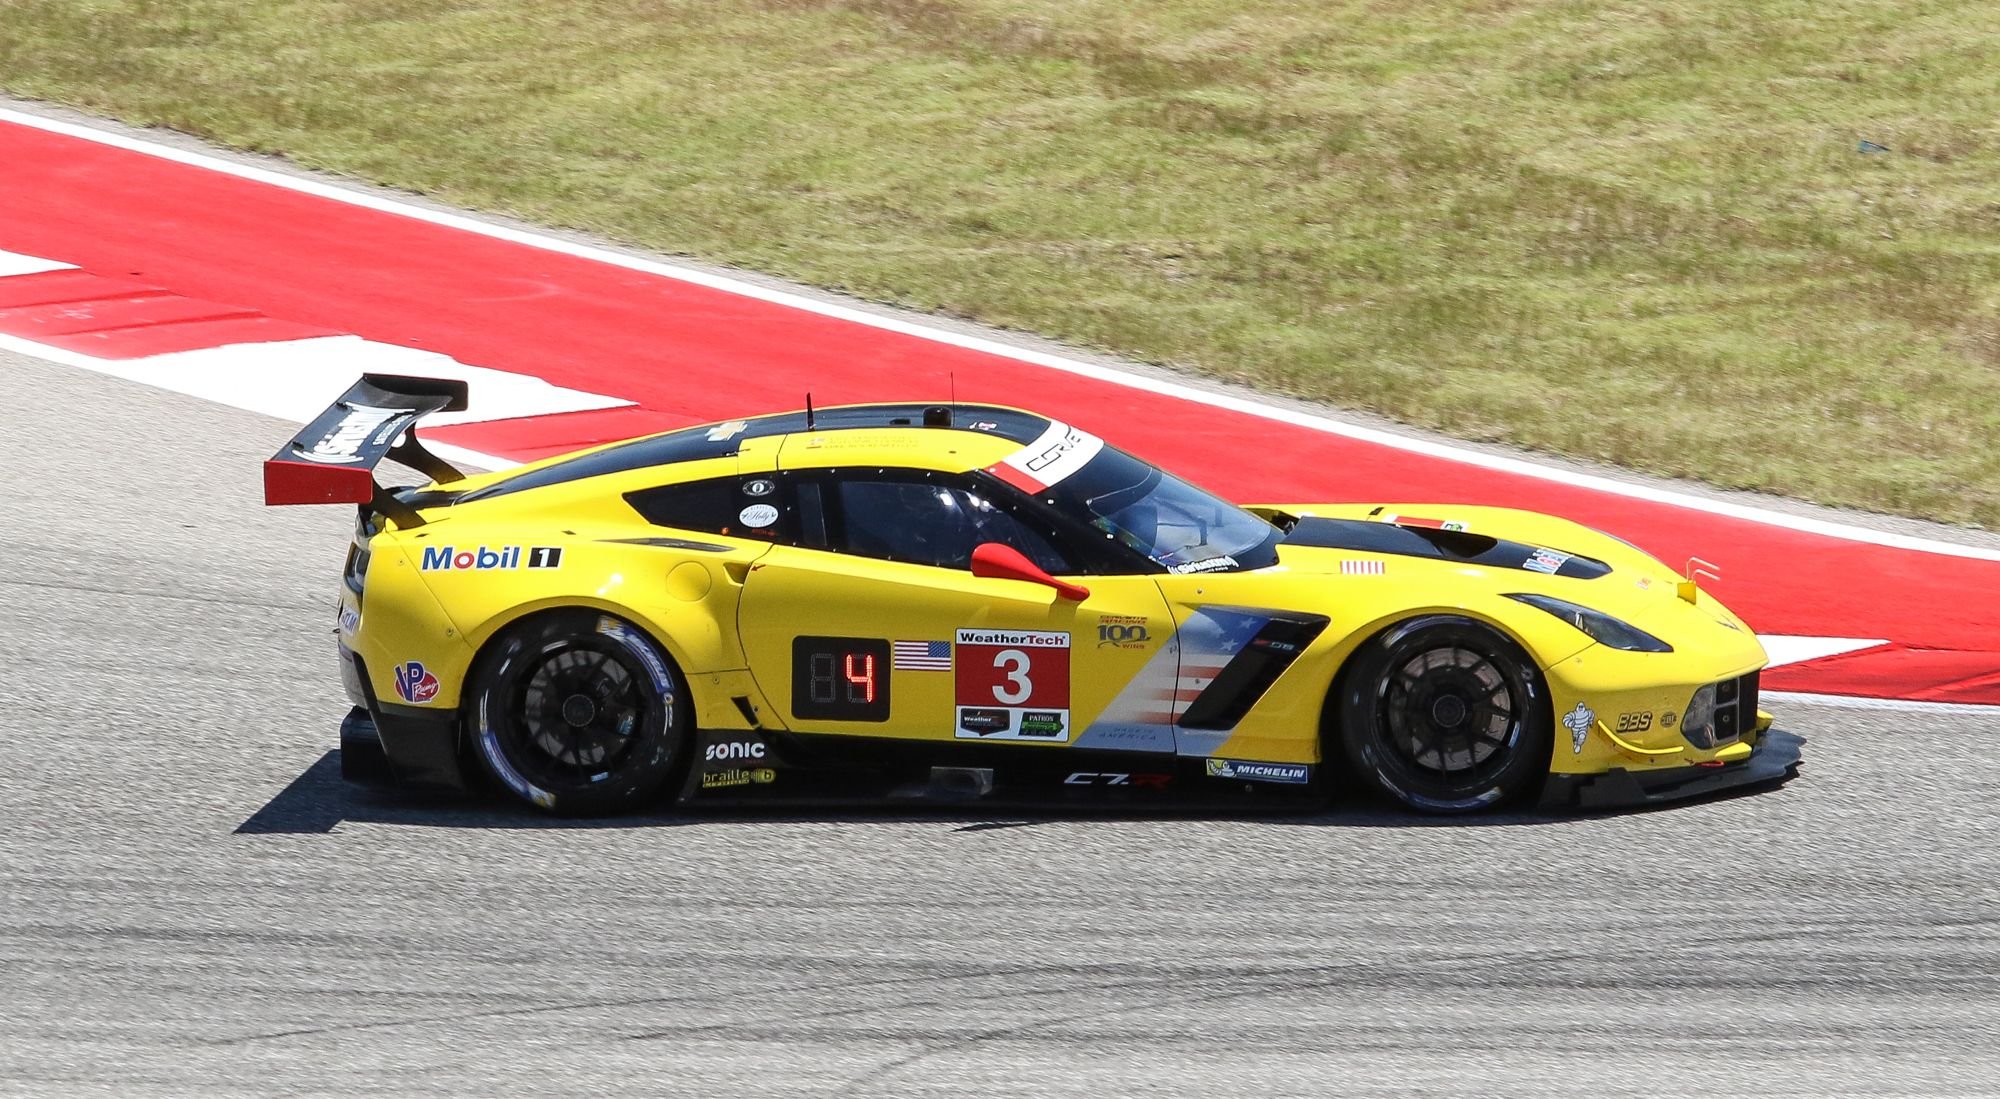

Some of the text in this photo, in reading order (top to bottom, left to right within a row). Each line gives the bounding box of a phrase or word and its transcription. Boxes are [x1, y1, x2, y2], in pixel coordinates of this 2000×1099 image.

[422, 546, 520, 570] Mobil
[1097, 624, 1147, 642] 100
[394, 662, 425, 703] VP
[845, 654, 873, 702] 4
[992, 649, 1032, 704] 3
[1616, 711, 1653, 733] BBS
[703, 768, 750, 784] braille
[1236, 765, 1305, 778] MICHELIN
